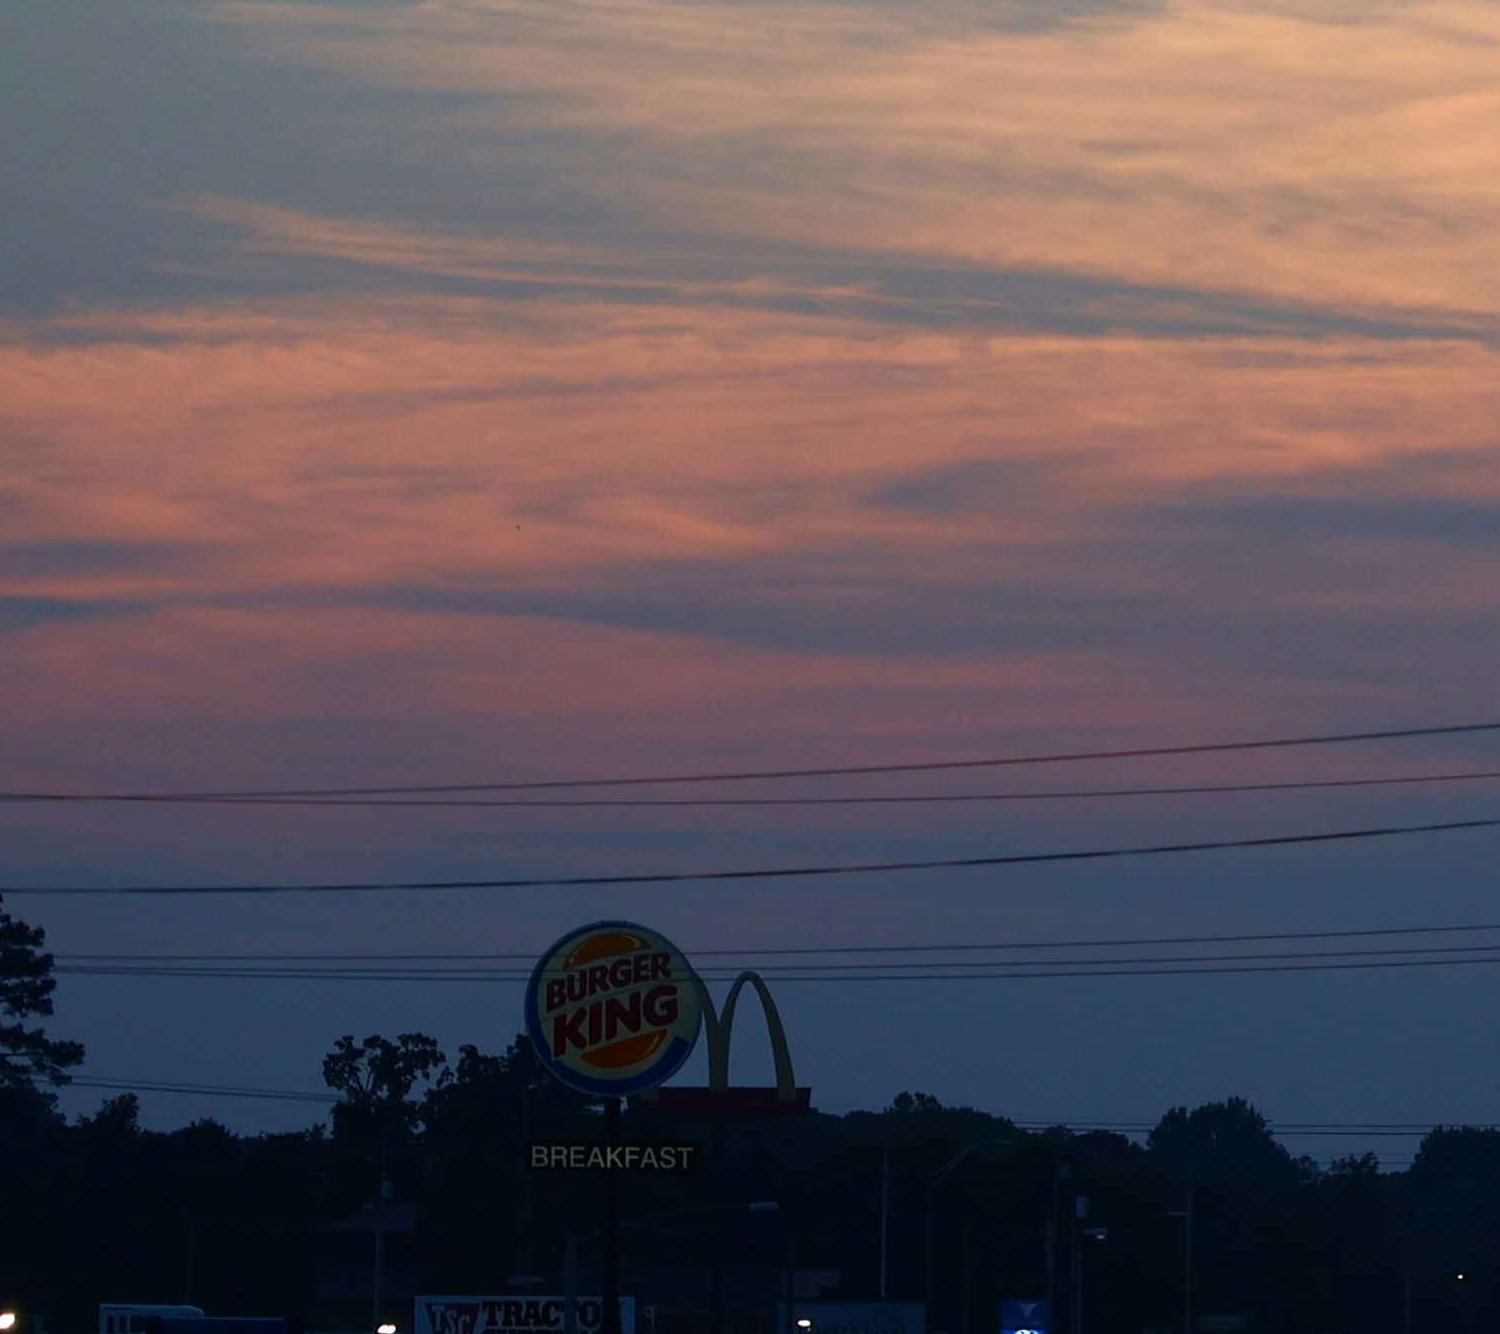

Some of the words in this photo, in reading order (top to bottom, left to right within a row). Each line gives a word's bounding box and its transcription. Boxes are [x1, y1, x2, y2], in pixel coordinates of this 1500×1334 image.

[545, 951, 672, 1014] BURGER
[553, 983, 679, 1058] KING
[530, 1144, 694, 1170] BREAKFAST
[482, 1301, 622, 1328] TRACO
